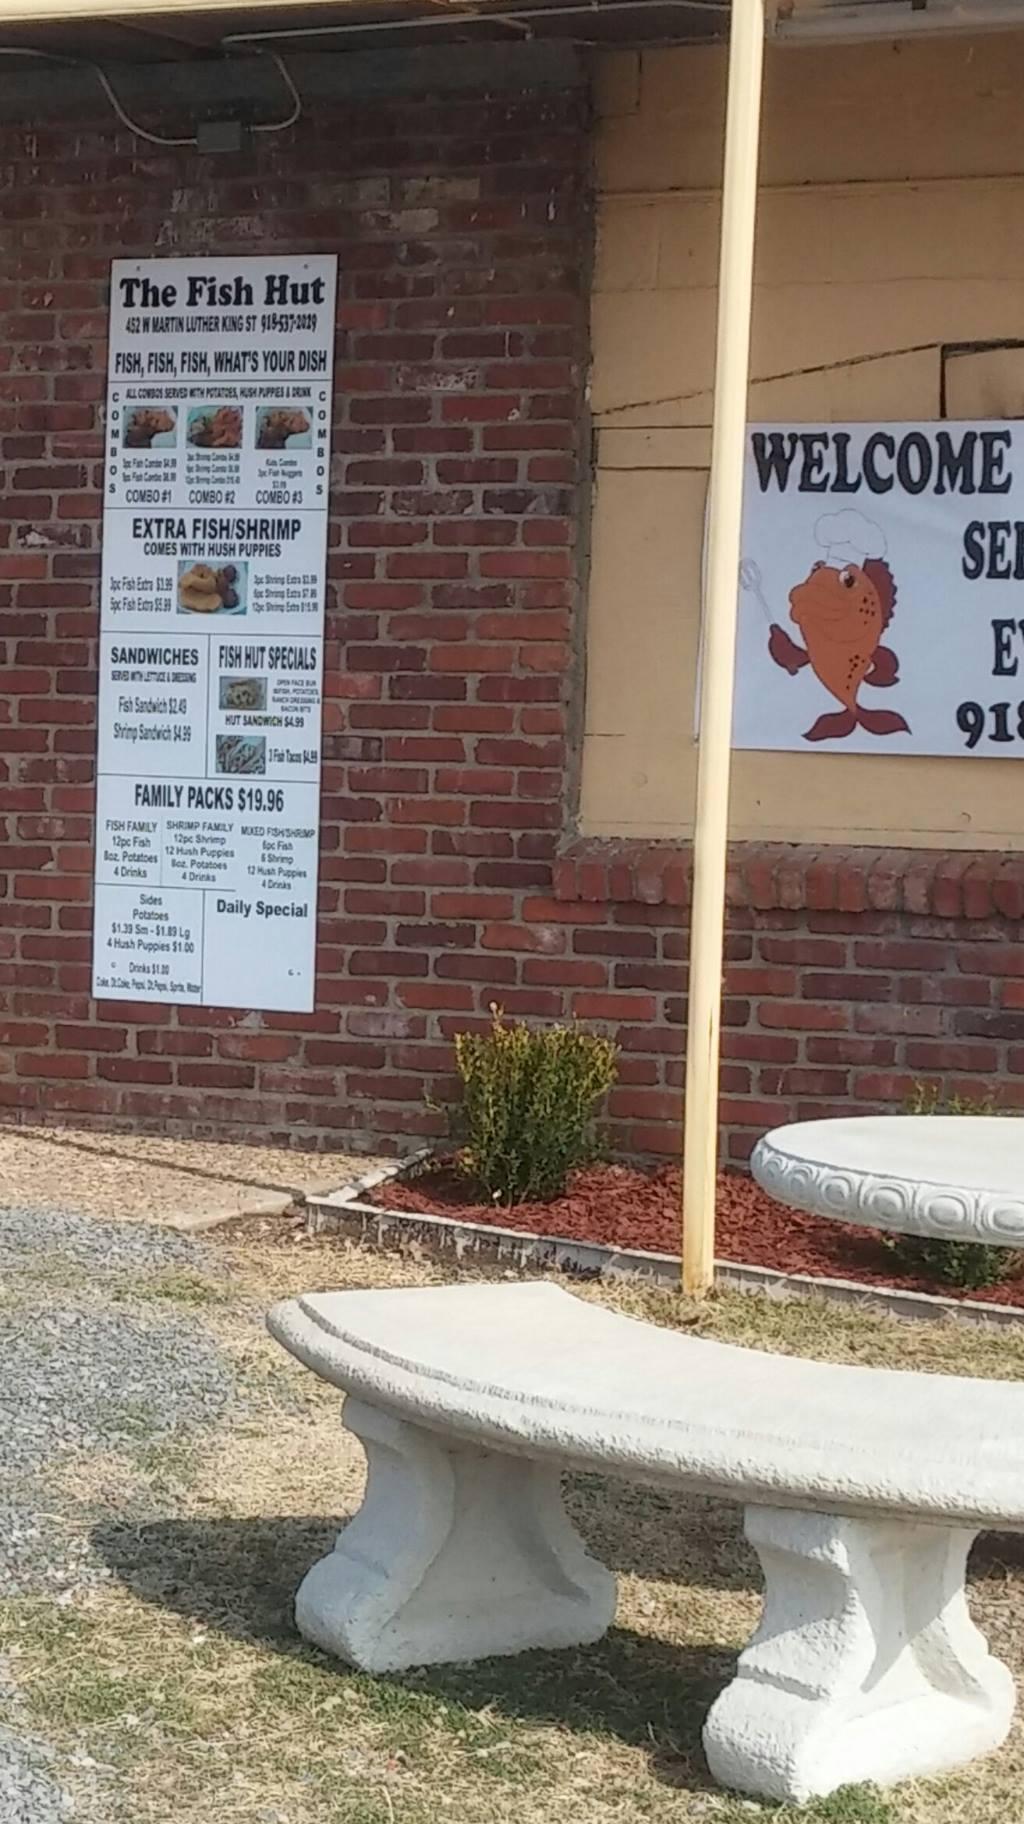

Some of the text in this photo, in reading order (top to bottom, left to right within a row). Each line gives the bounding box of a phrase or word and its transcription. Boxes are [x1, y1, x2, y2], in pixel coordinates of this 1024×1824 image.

[120, 274, 326, 308] The Fish Hut
[125, 317, 141, 334] 452
[142, 317, 151, 333] W
[152, 316, 184, 333] MARTIN
[186, 316, 220, 332] LUTHER
[222, 315, 244, 332] KING
[246, 315, 257, 332] ST
[115, 349, 327, 377] FISH, FISH, FISH, WHAT'S YOUR DISH
[126, 388, 137, 399] ALL
[138, 388, 162, 399] COMBOS
[164, 387, 188, 399] SERVED
[189, 387, 204, 398] WITH
[240, 387, 257, 398] HUSH
[258, 387, 284, 398] PUPPIES
[292, 386, 311, 397] DRINK
[752, 430, 1013, 495] WELCOME
[125, 489, 172, 504] COMBO #1
[189, 490, 236, 505] COMBO #2
[256, 491, 304, 505] COMBO #3
[132, 518, 301, 541] EXTRA FISH/SHRIMP
[143, 542, 282, 558] COMES WITH HUSH PUPPIES
[111, 647, 199, 666] SANDWICHES
[219, 645, 317, 670] FISH HUT SPECIALS
[119, 696, 133, 713] Fish
[135, 697, 168, 714] Sandwich
[225, 715, 304, 728] HUT SANDWICH $4.99
[113, 723, 138, 744] Shrimp
[139, 724, 172, 742] Sandwich
[135, 784, 284, 813] FAMILY PACKS $19.96
[106, 819, 158, 833] FISH FAMILY
[166, 820, 234, 833] SHRIMP FAMILY
[241, 826, 316, 839] MIXED FISH/SHRIMP
[112, 836, 151, 849] 12pc Fish
[174, 834, 226, 846] 12pc Shrimp
[277, 840, 293, 851] Fish
[122, 851, 158, 864] Potatoes
[165, 846, 235, 860] 12 Hush Puppies
[267, 853, 294, 865] Shrimp
[190, 859, 228, 870] Potatoes
[113, 867, 147, 878] 4 Drinks
[182, 872, 216, 883] 4 Drinks
[247, 866, 307, 879] 12 Hush Puppies
[261, 879, 291, 890] 4 Drinks
[139, 893, 162, 906] Sides
[133, 908, 169, 921] Potatoes
[217, 899, 308, 918] Daily Special
[135, 923, 149, 935] Sm
[179, 928, 190, 940] Lg
[107, 938, 113, 949] 4
[114, 939, 136, 950] Hush
[137, 940, 170, 953] Puppies
[129, 962, 150, 975] Drinks
